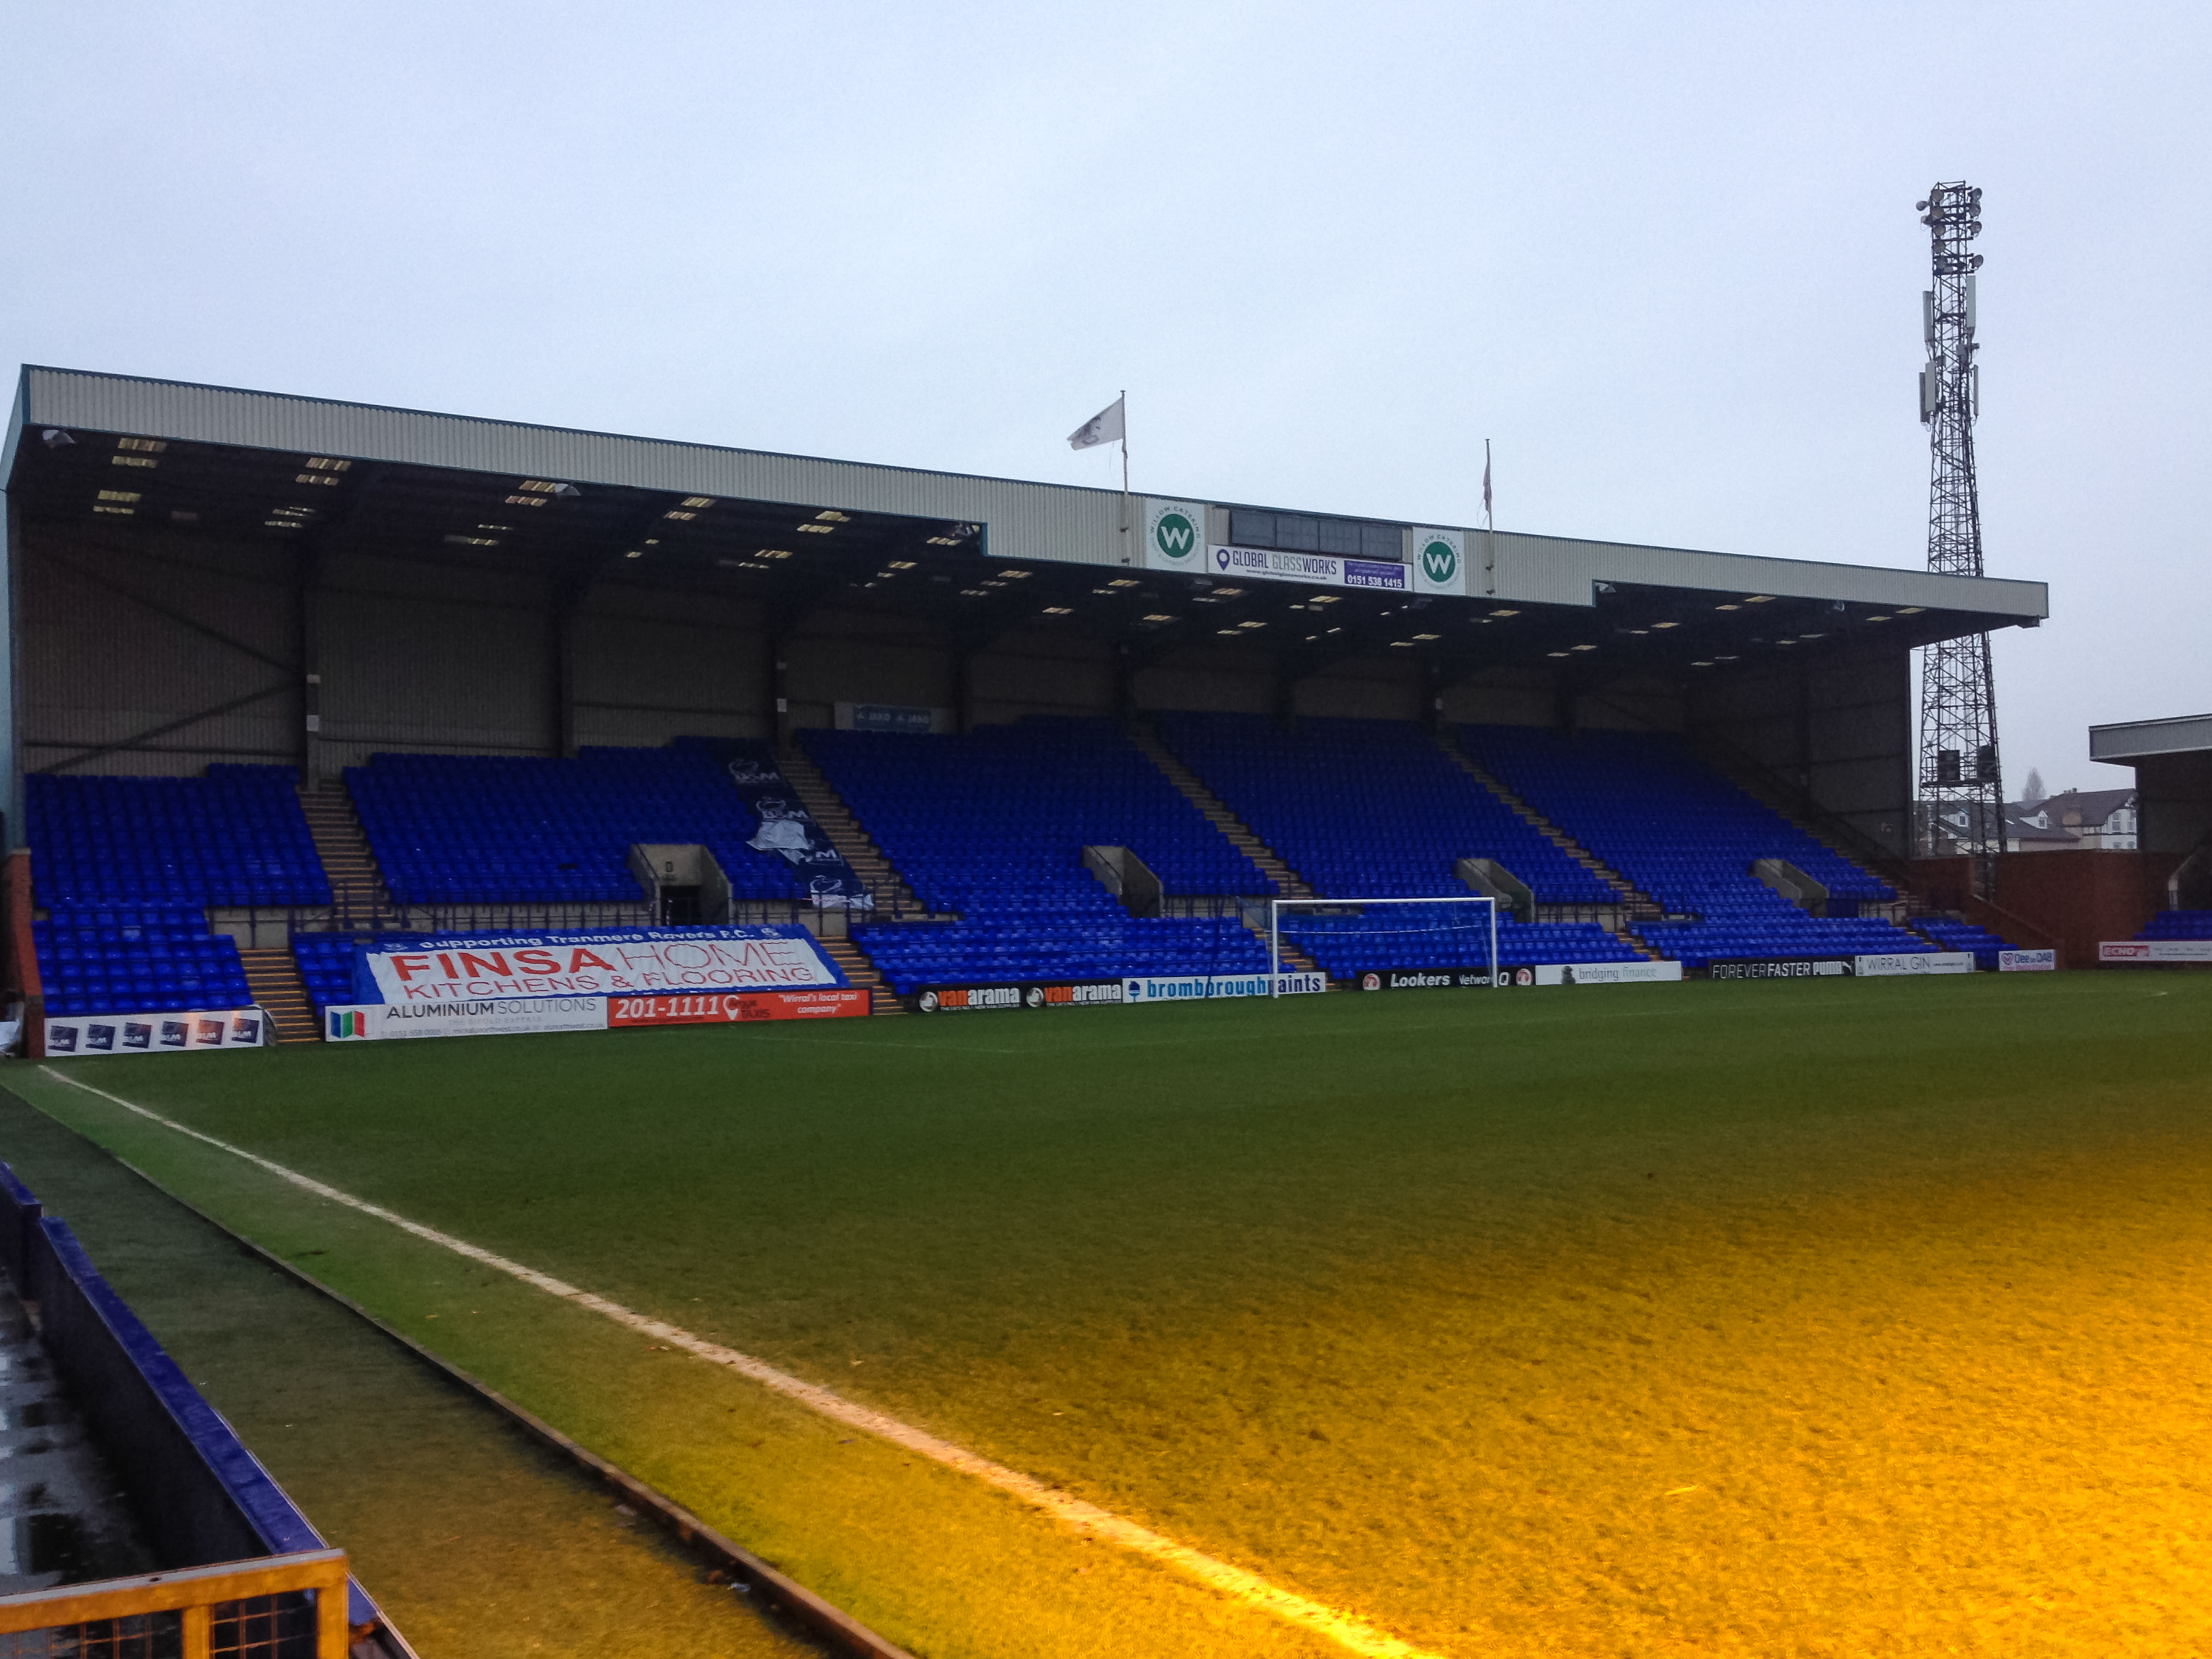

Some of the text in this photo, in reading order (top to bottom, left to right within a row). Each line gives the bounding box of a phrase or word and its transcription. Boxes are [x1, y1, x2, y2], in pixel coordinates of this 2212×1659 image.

[1150, 506, 1201, 538] WILLOW CATERING
[1161, 526, 1190, 549] W
[1233, 550, 1268, 568] GLOBAL
[1272, 555, 1337, 575] GLASSWORKS
[1426, 553, 1452, 574] W
[1347, 574, 1402, 588] 0151 538 1415
[389, 942, 805, 981] FINSA HOME
[1868, 956, 1930, 970] WIRRAL GIN
[2015, 954, 2029, 963] Dee
[1391, 973, 1451, 987] Lookers
[1579, 966, 1657, 981] bridging finance
[403, 967, 814, 999] KITCHENS & FLOORING
[819, 993, 839, 1001] local
[938, 988, 1020, 1006] vanarama
[1044, 984, 1121, 1002] vanarama
[615, 996, 718, 1019] 201-1111
